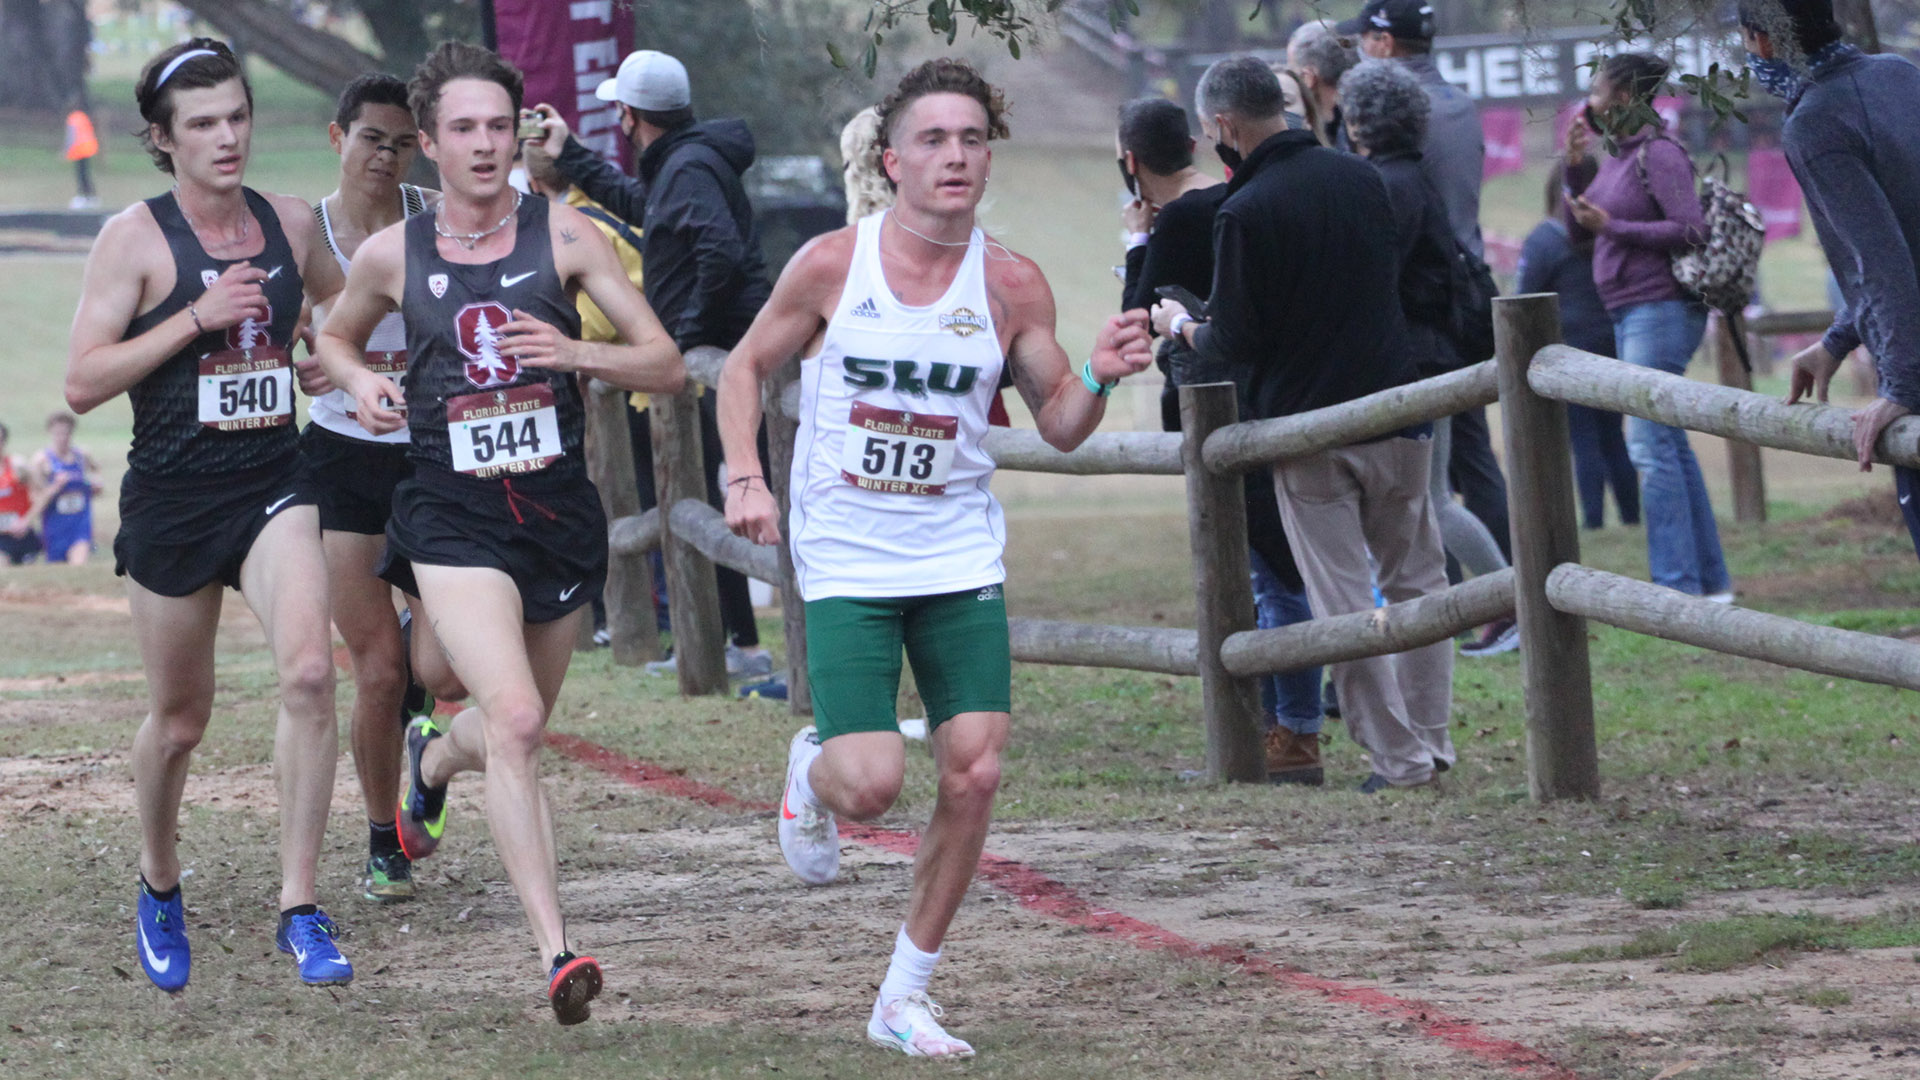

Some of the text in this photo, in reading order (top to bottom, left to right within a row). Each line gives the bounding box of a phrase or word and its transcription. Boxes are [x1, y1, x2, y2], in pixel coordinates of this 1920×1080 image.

[215, 359, 279, 374] FLORIDA STATE
[366, 363, 393, 371] ORIDA
[843, 356, 982, 400] SLU
[219, 375, 278, 417] 540
[462, 399, 540, 420] FLORIDA STATE
[218, 416, 279, 431] WINTER XC
[864, 418, 945, 439] FLORIDA STATE
[470, 416, 541, 463] 544
[476, 458, 546, 478] WINTER XC
[862, 436, 936, 480] 513
[857, 477, 930, 494] WINTER XC
